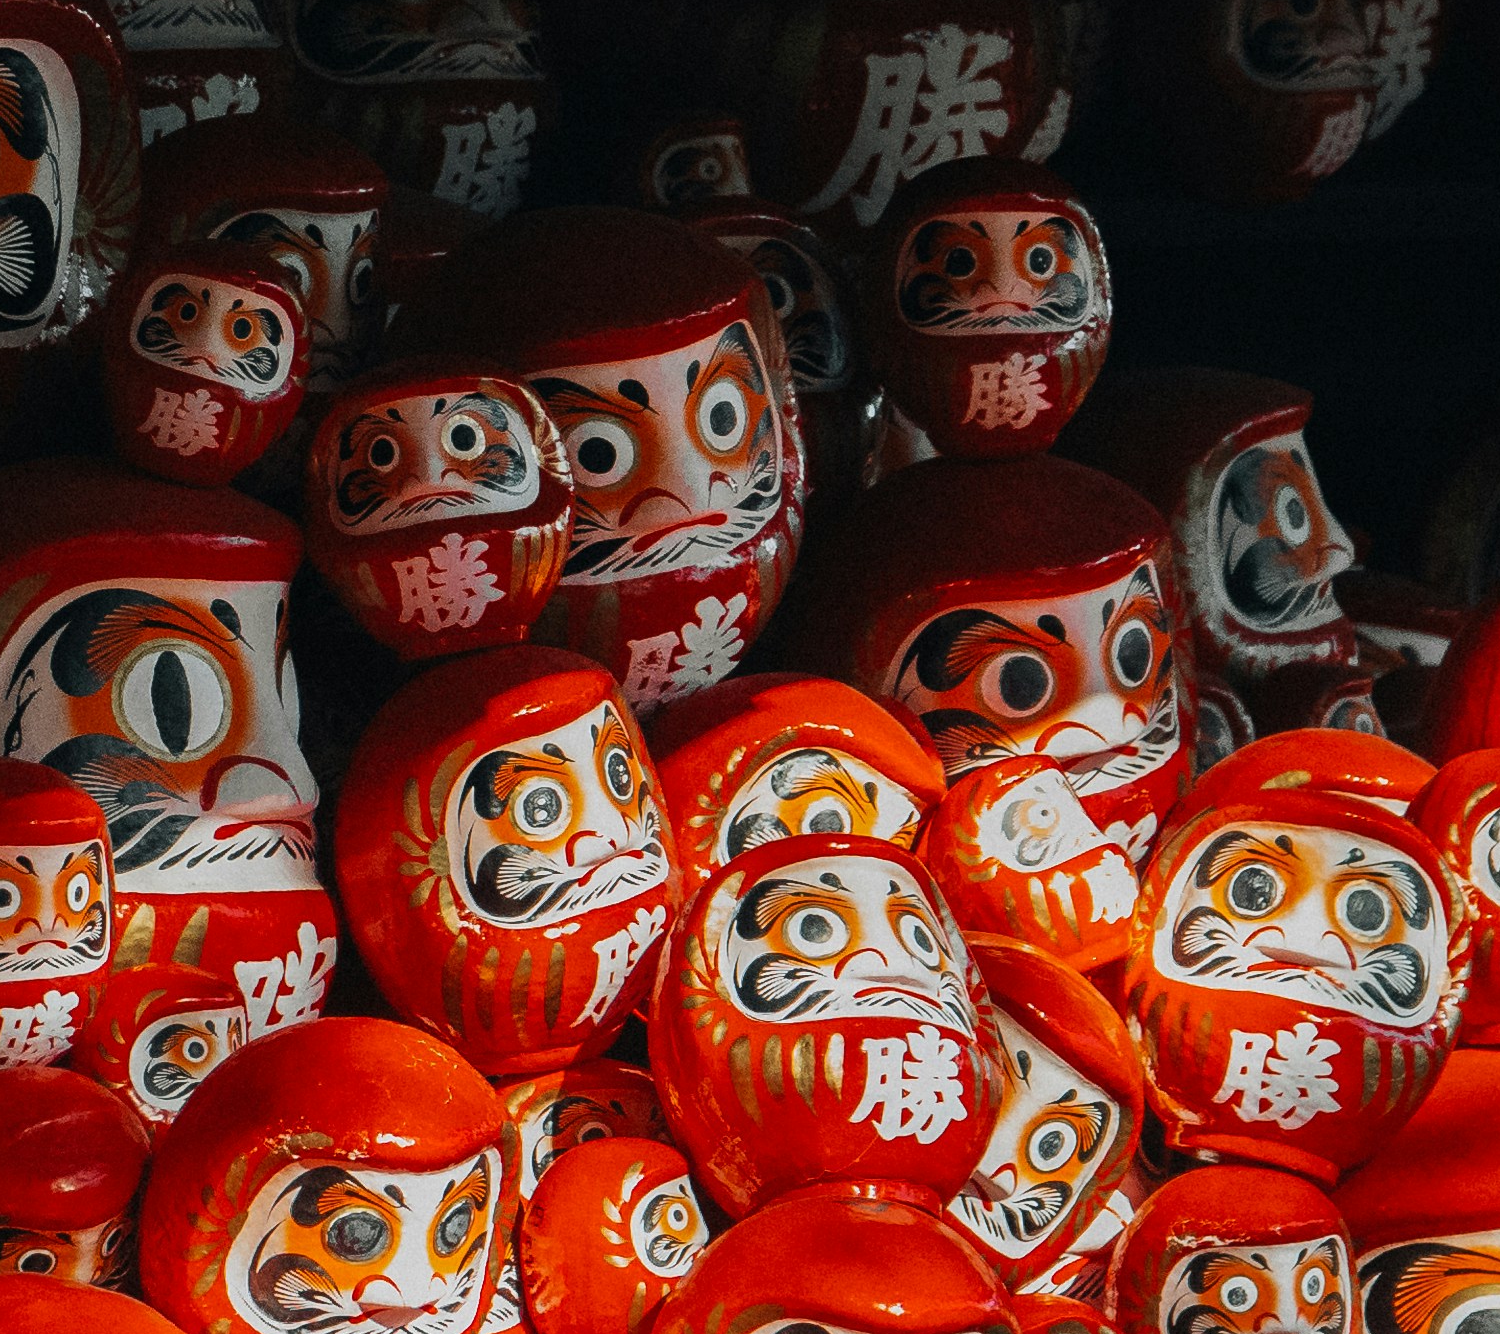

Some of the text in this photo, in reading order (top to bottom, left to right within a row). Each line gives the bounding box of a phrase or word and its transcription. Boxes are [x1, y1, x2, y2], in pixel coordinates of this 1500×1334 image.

[433, 101, 535, 219] 勝
[802, 21, 1013, 227] 勝
[136, 388, 224, 457] 勝
[963, 349, 1053, 431] 勝
[391, 533, 507, 633] 勝
[850, 1023, 968, 1145] 勝
[1211, 1023, 1341, 1131] 勝
